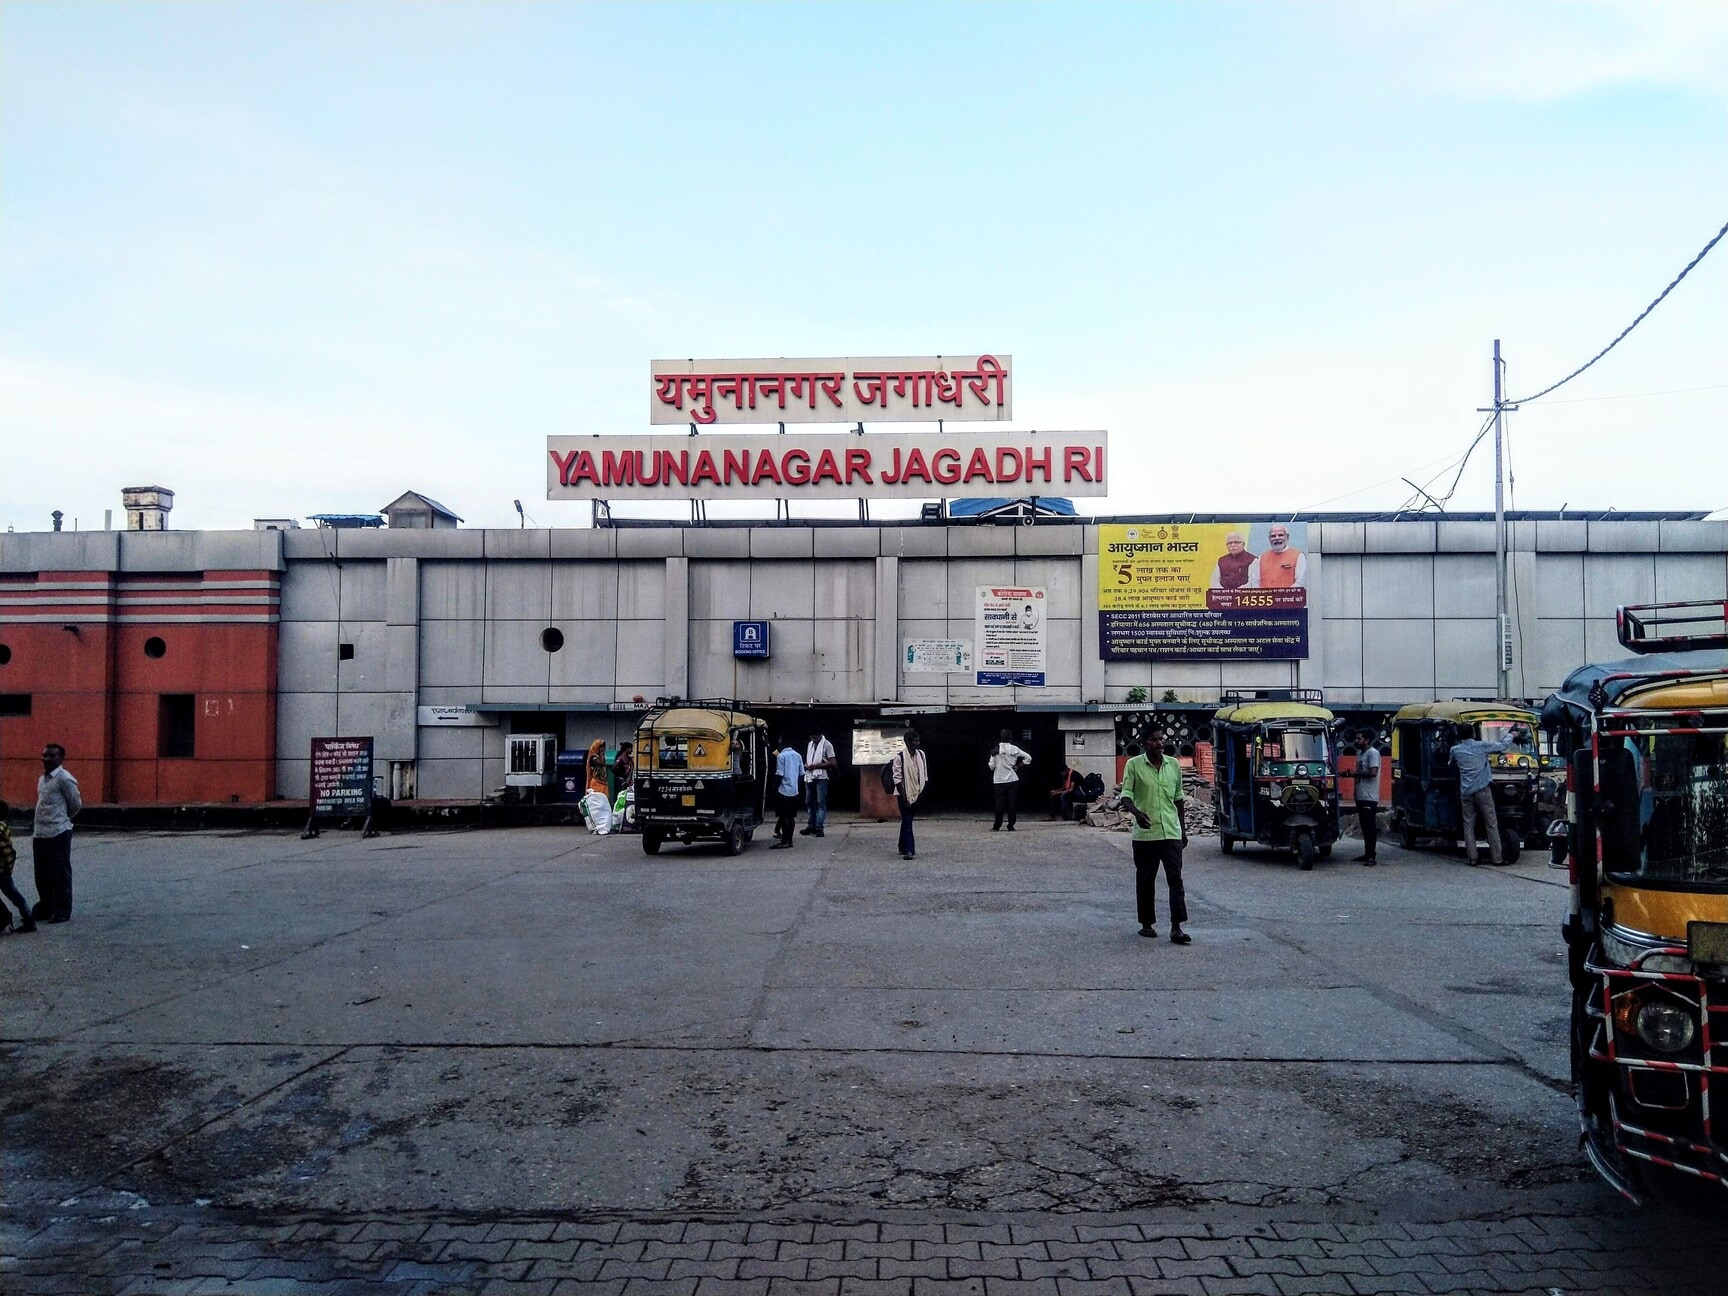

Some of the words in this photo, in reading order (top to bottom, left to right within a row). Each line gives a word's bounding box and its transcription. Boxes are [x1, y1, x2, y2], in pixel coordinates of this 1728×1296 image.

[654, 372, 845, 424] यमुनानगर
[853, 354, 1007, 407] जगाधरी
[549, 447, 873, 486] YAMUNANAGAR
[1107, 542, 1164, 557] आयुष्मान
[1166, 541, 1199, 552] भारत
[1235, 595, 1274, 606] 14555
[332, 788, 362, 796] PARKING
